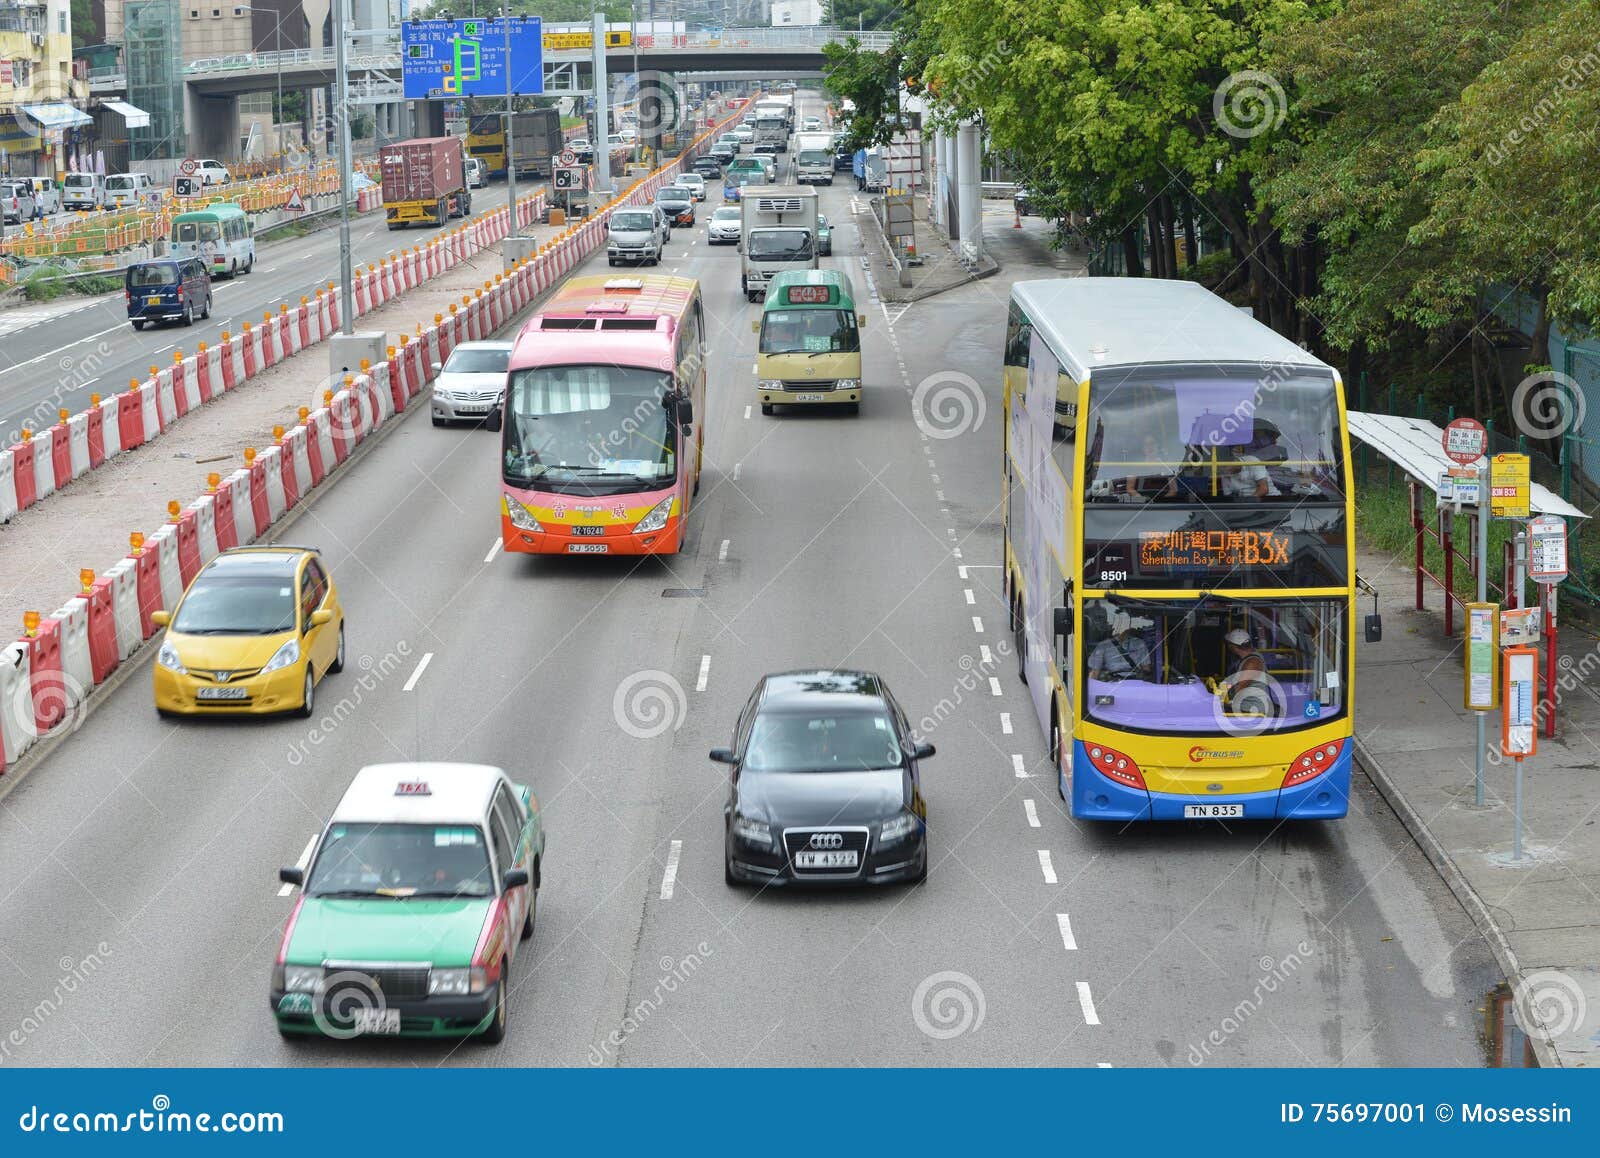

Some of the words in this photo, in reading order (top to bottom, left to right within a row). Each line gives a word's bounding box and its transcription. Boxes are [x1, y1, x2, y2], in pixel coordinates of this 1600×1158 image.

[384, 154, 404, 165] ZIM
[564, 153, 572, 161] 70
[1504, 487, 1517, 497] B3X
[1142, 531, 1244, 551] 深圳灣口岸
[1141, 551, 1189, 565] Shenzhen
[1193, 551, 1215, 566] Bay
[1218, 551, 1244, 565] Port
[1101, 571, 1128, 581] 8501
[399, 783, 429, 793] TAXI
[1191, 806, 1207, 816] TN
[1212, 806, 1237, 816] 835
[800, 857, 816, 865] TW
